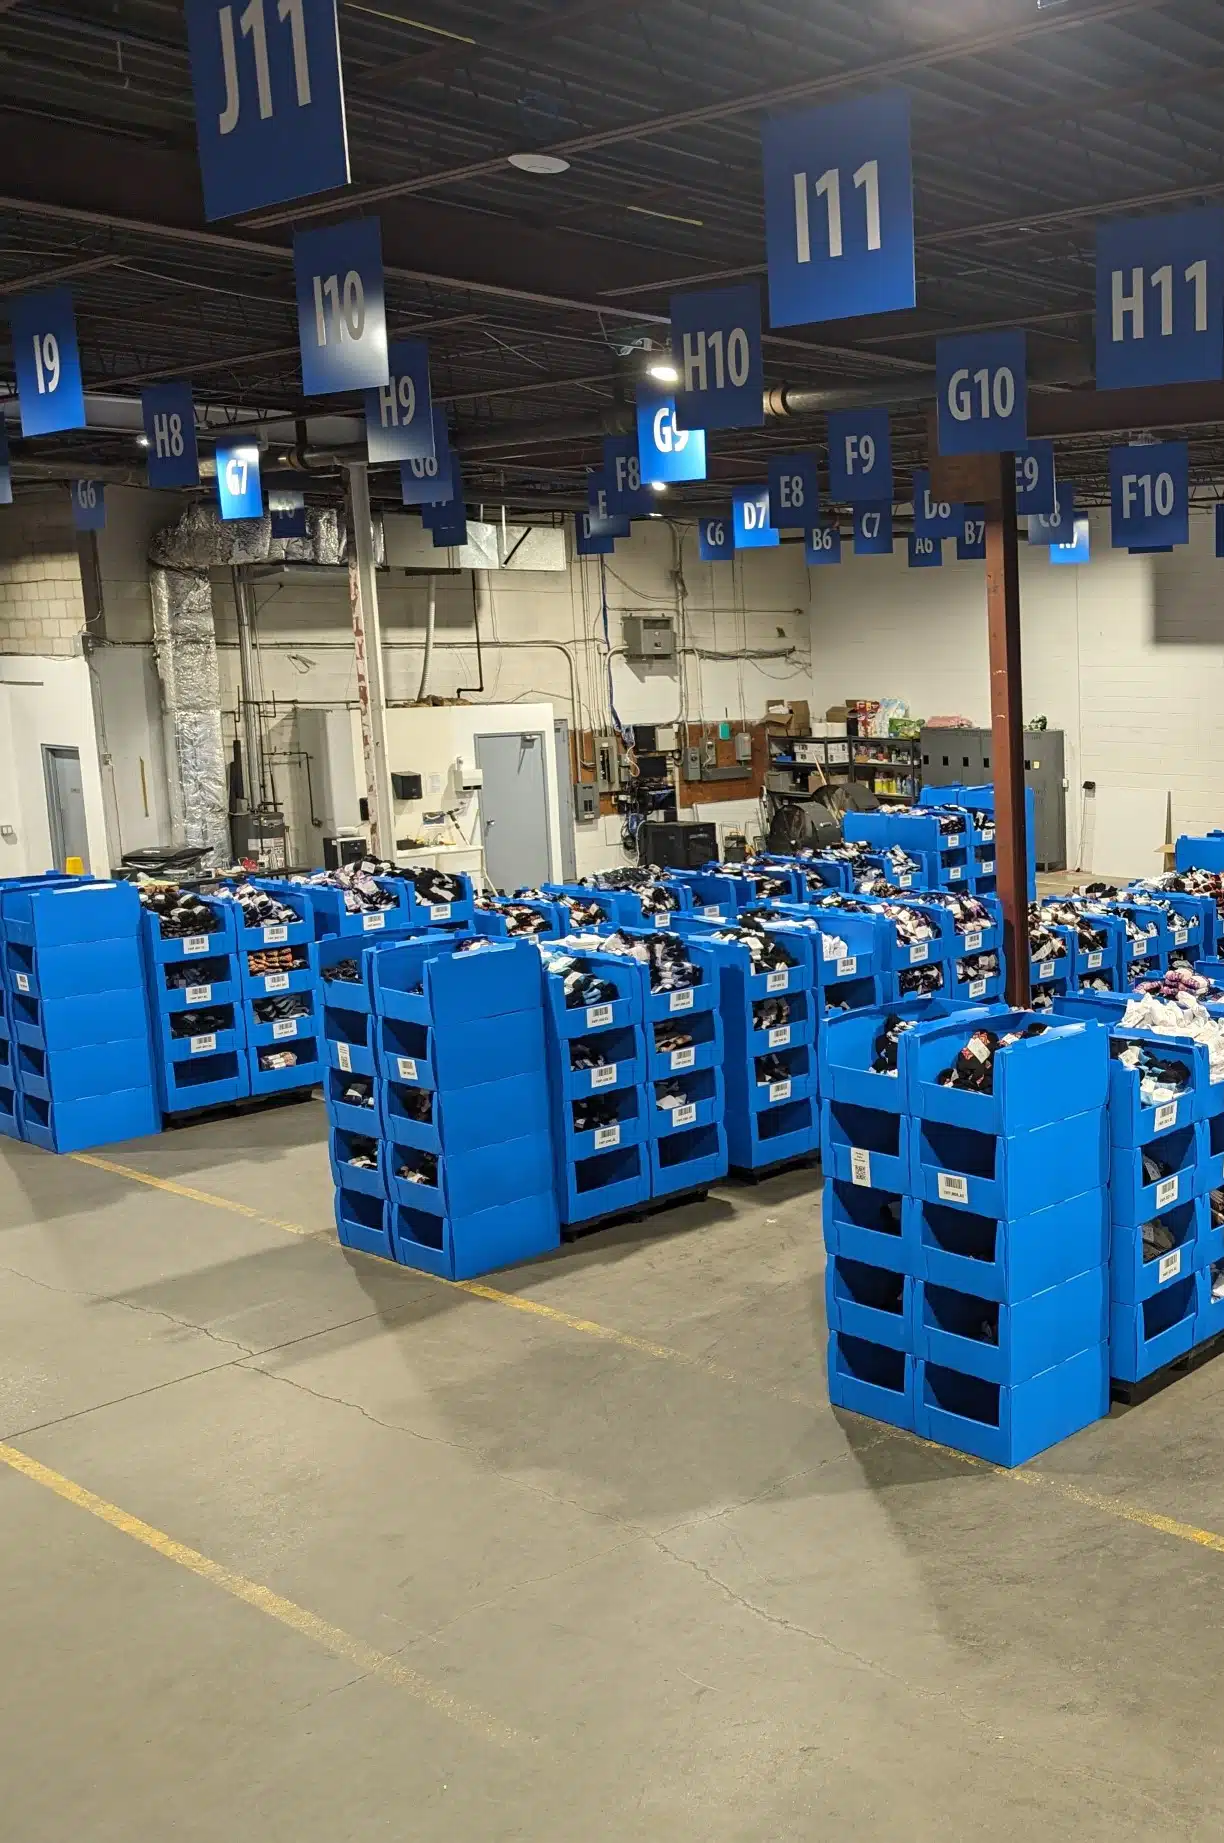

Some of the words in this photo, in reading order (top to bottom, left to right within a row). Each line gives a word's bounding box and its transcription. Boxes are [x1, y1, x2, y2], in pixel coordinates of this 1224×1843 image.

[218, 0, 312, 135] J11
[793, 160, 881, 264] I11
[313, 270, 366, 346] I10
[1111, 260, 1207, 342] H11
[33, 333, 60, 394] I9
[683, 327, 750, 392] H10
[379, 375, 416, 428] H9
[948, 366, 1015, 421] G10
[153, 413, 184, 459] H8
[845, 435, 875, 475] F9
[77, 480, 97, 509] G6
[225, 459, 248, 496] G7
[615, 456, 640, 492] F8
[780, 475, 804, 508] E8
[1121, 472, 1174, 519] F10
[706, 521, 725, 546] C6
[743, 502, 769, 530] D7
[861, 512, 881, 538] C7
[965, 520, 985, 545] B7
[812, 527, 832, 551] B6
